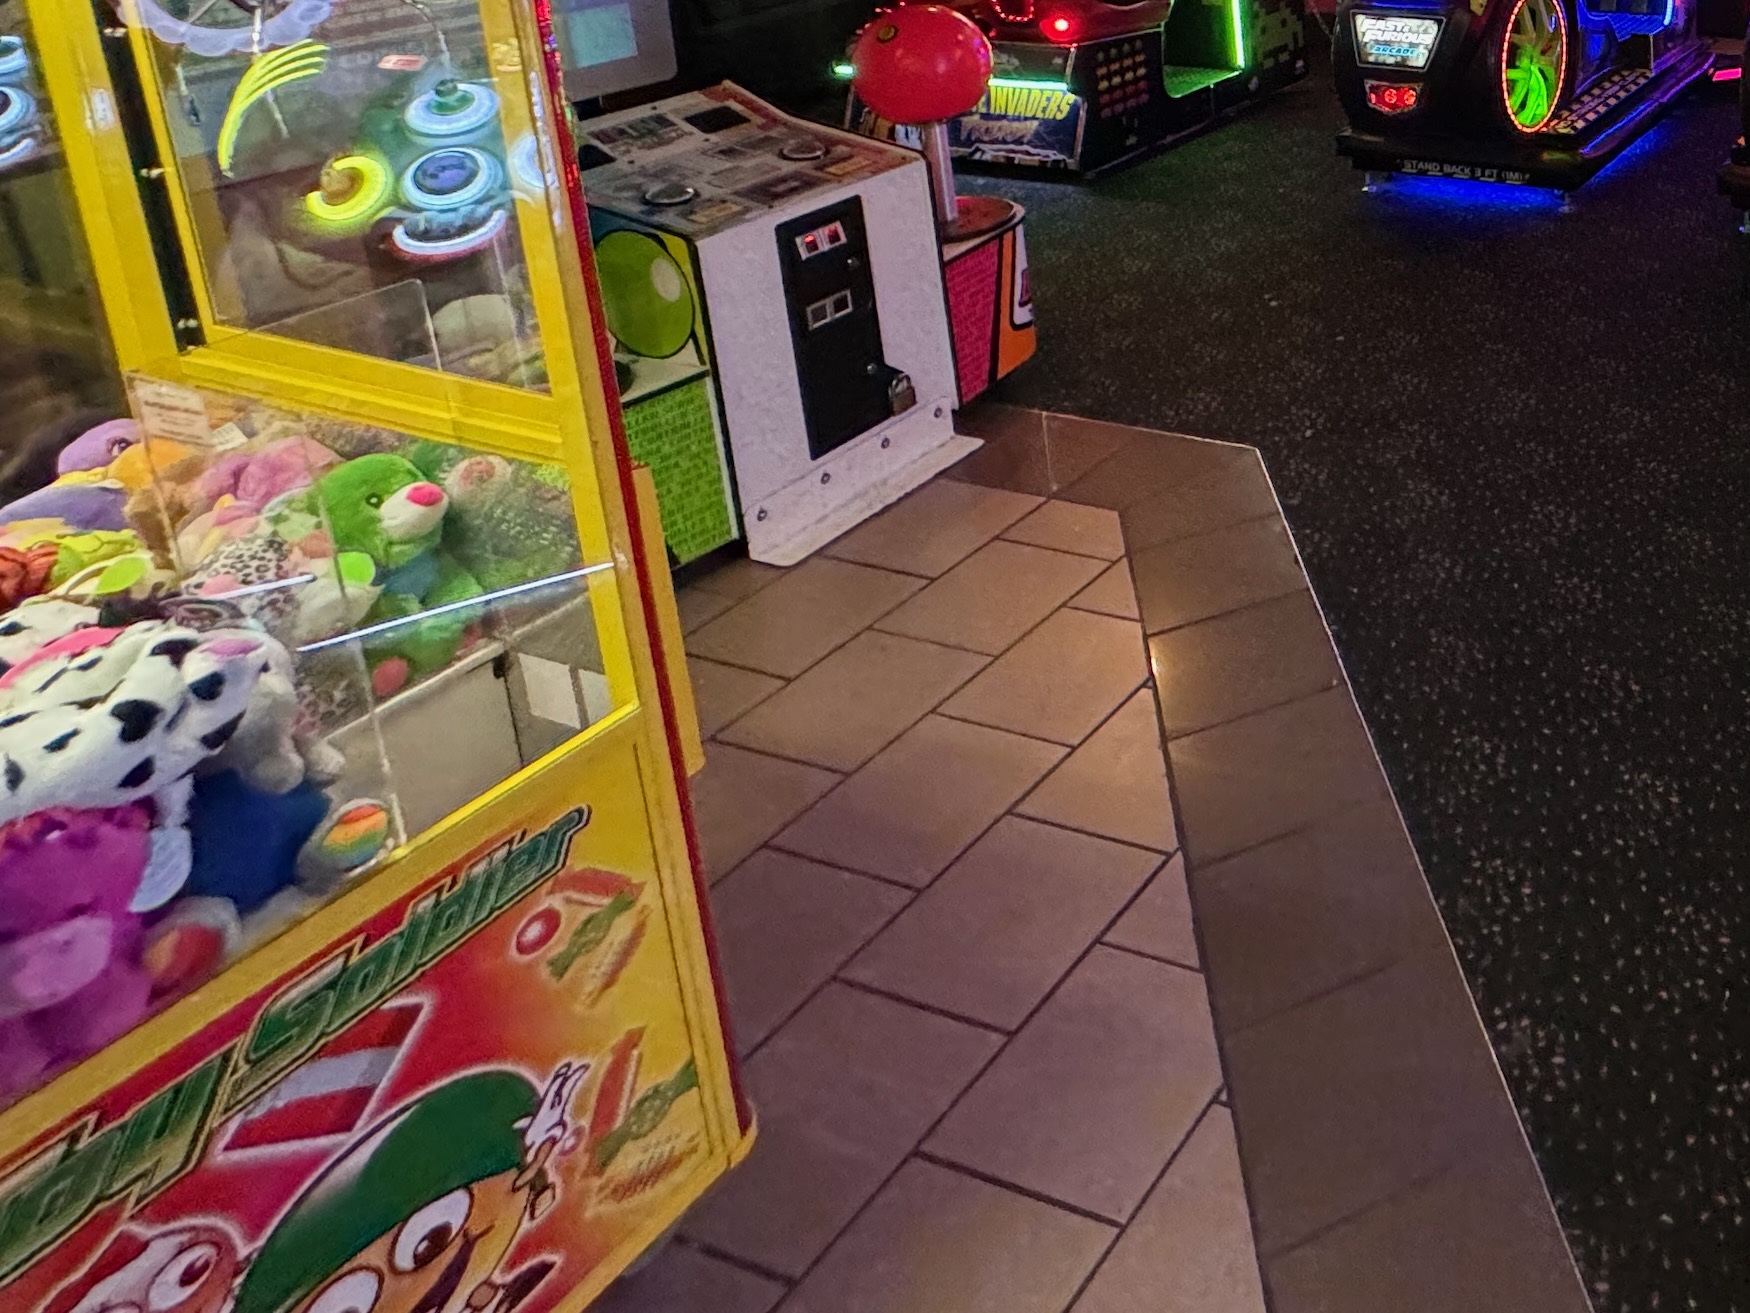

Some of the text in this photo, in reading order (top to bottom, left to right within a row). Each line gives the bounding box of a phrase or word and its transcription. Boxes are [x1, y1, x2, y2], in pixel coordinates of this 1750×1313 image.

[1363, 29, 1435, 44] FURIOUS
[989, 85, 1077, 121] INVADERS
[1403, 159, 1441, 172] STAND
[1443, 162, 1471, 176] BACK
